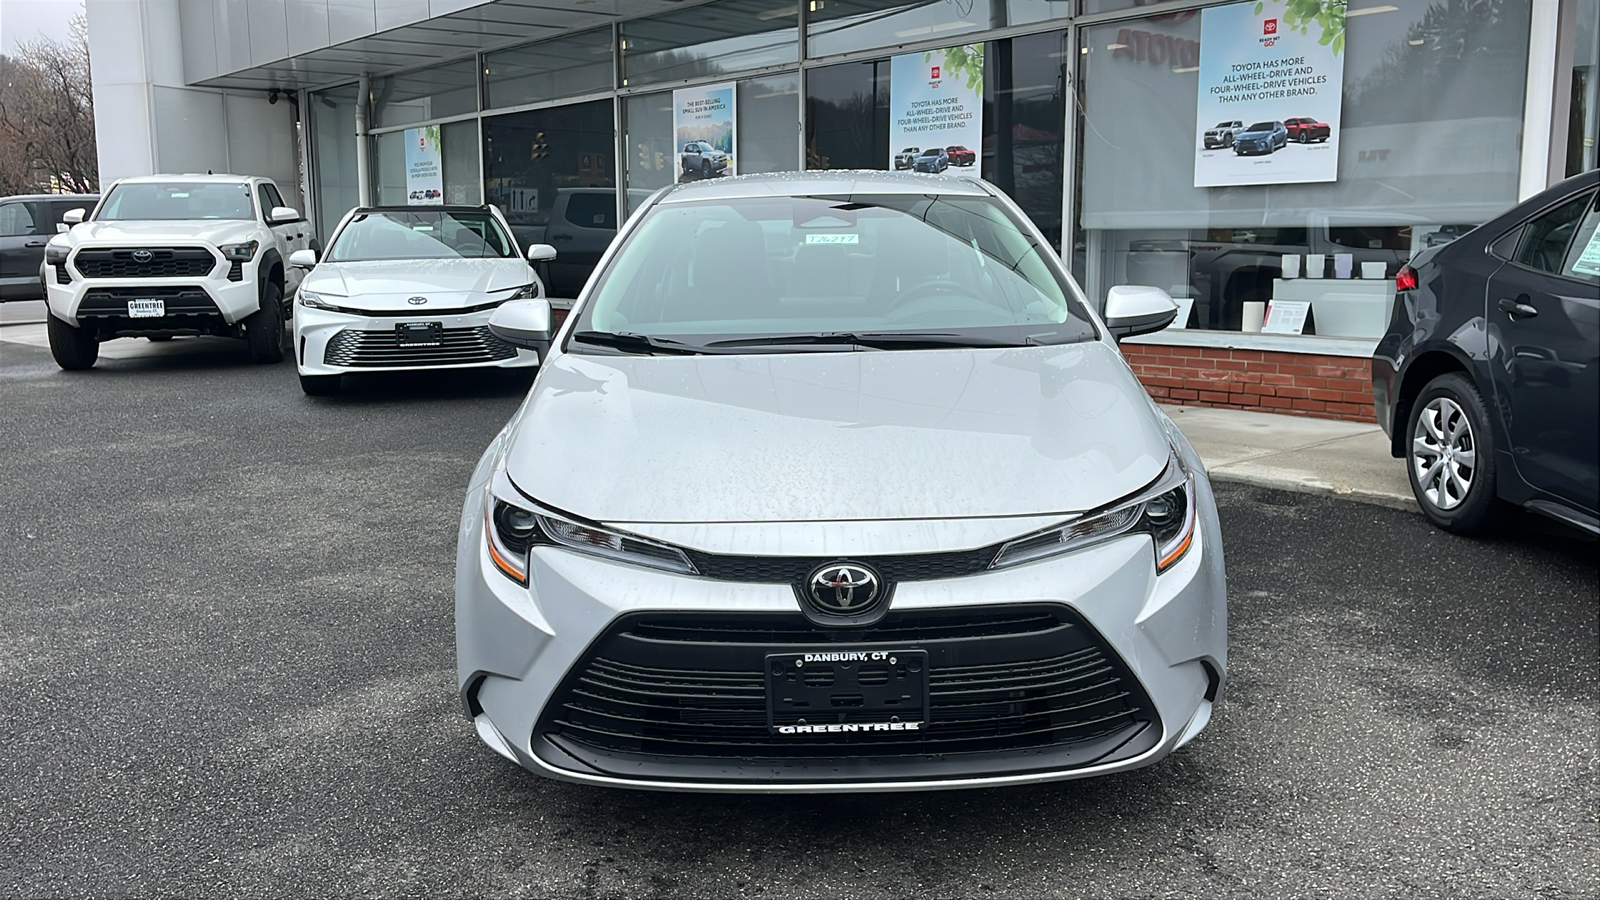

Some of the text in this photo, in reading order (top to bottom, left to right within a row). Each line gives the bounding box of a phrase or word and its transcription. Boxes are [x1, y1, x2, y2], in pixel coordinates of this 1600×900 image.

[1232, 57, 1305, 73] TOYOTA HAS MORE
[1223, 66, 1313, 84] ALL-WHEEL-DRIVE AND
[1210, 75, 1327, 94] FOUR-WHEEL-DRIVE VEHICLES
[1219, 87, 1317, 103] THAN ANY OTHER BRAND.
[911, 97, 958, 108] TOYOTA HAS MORE
[906, 106, 951, 117] ALL-WHEEL-DRIVE
[897, 113, 973, 126] FOUR-WHEEL-DRIVE VEHICLES
[929, 123, 947, 131] OTHER
[947, 121, 967, 129] BRAND.
[130, 302, 163, 310] GREENTREE
[804, 651, 889, 663] DANBURY, CT
[778, 722, 920, 734] GREENTREE
